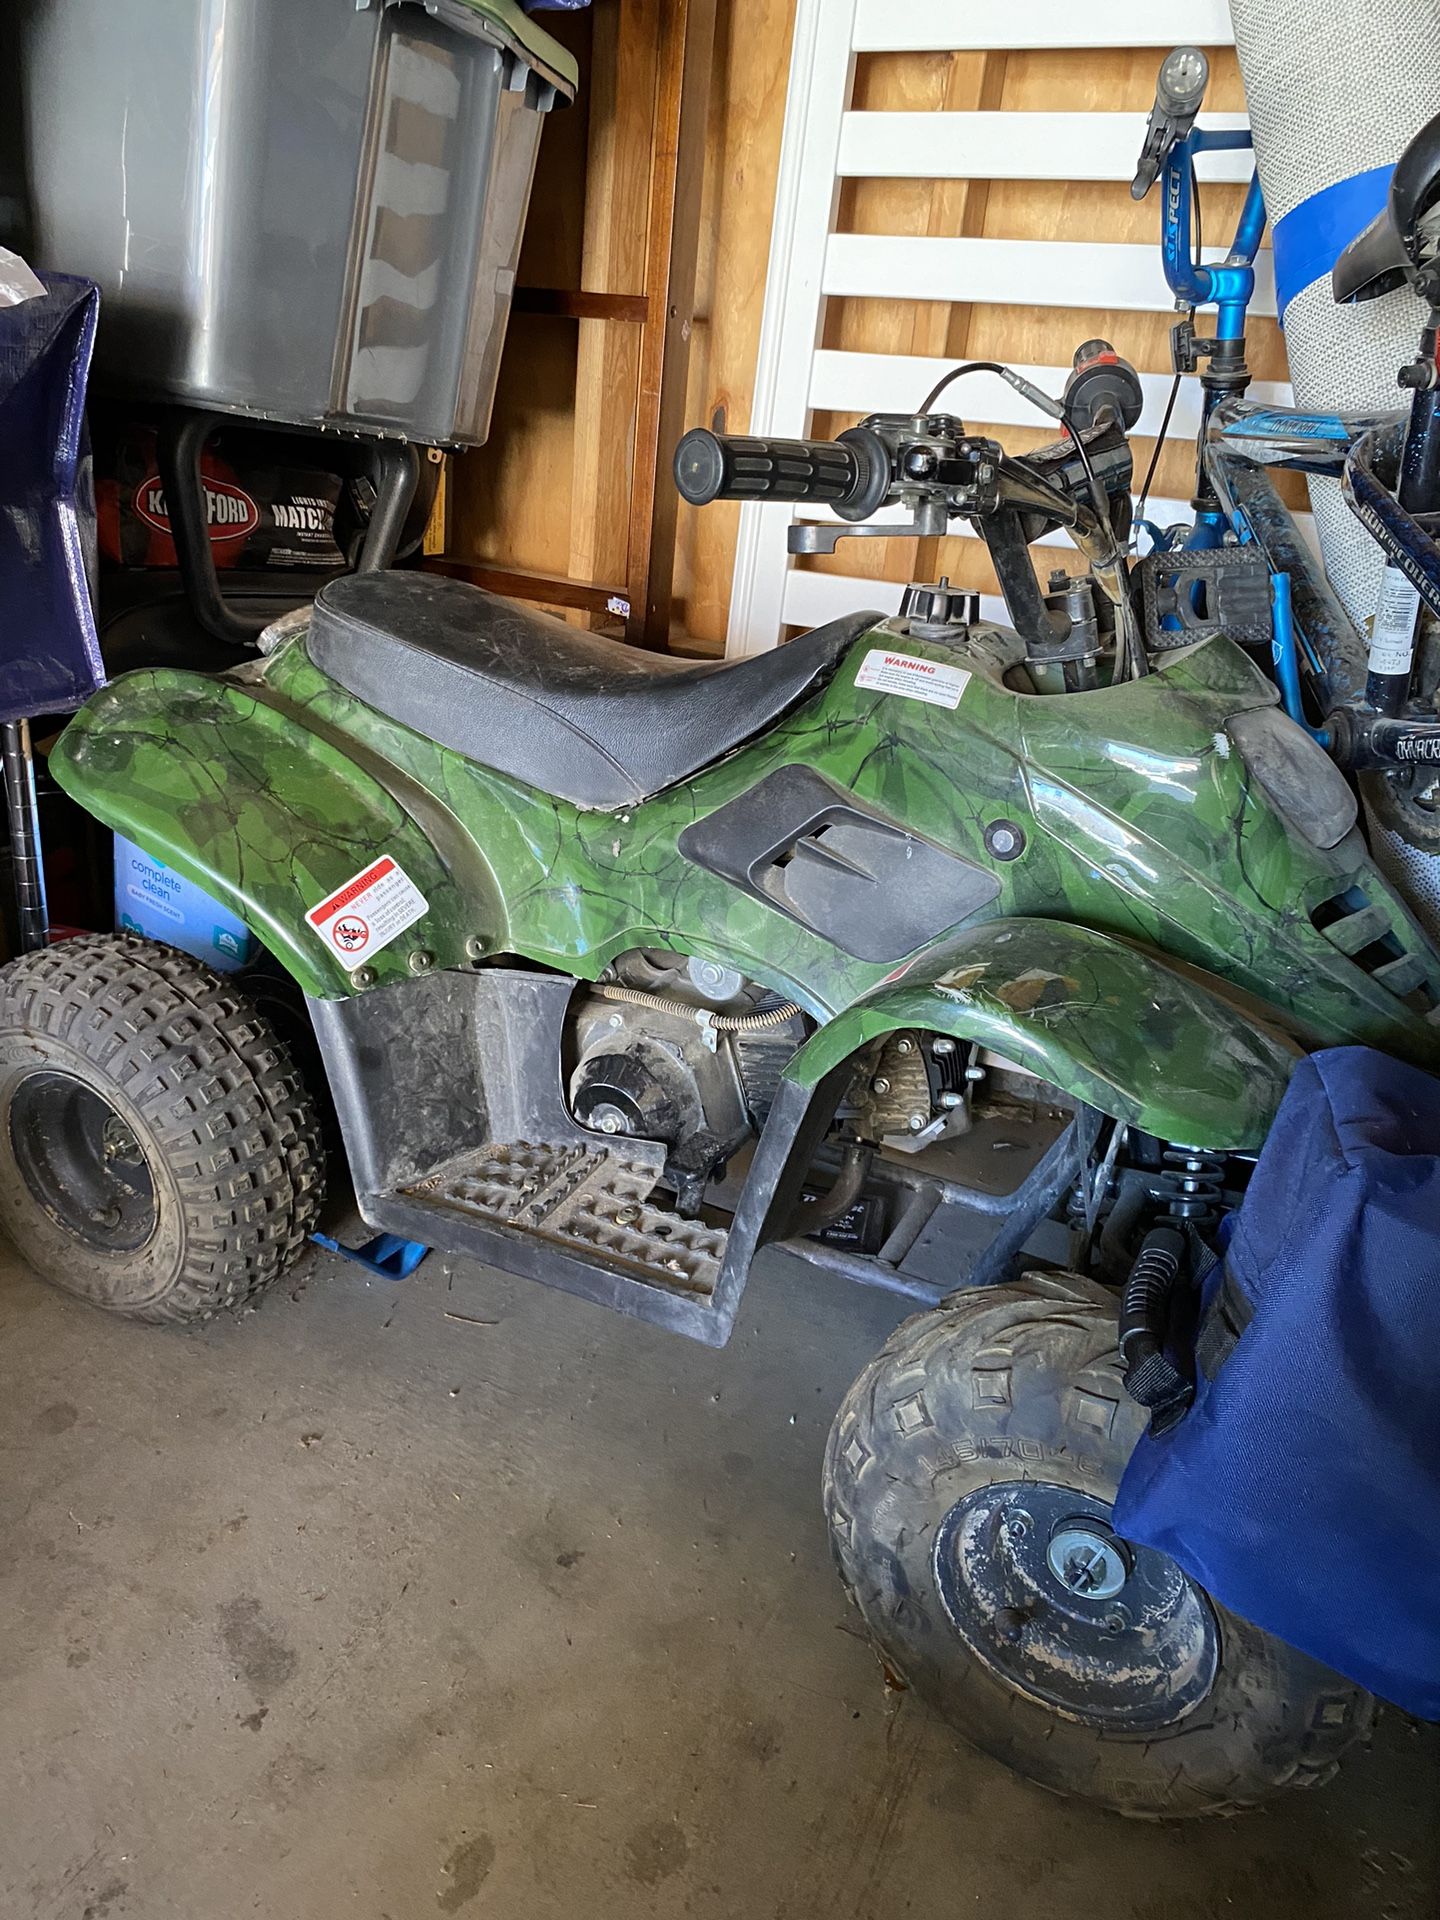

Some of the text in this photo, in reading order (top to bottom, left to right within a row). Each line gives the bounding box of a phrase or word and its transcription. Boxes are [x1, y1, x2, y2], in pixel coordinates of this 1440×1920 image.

[1360, 503, 1387, 539] RUN
[884, 656, 936, 675] WARNING
[131, 859, 182, 893] complete
[142, 878, 170, 901] clean
[340, 872, 378, 904] WARNING
